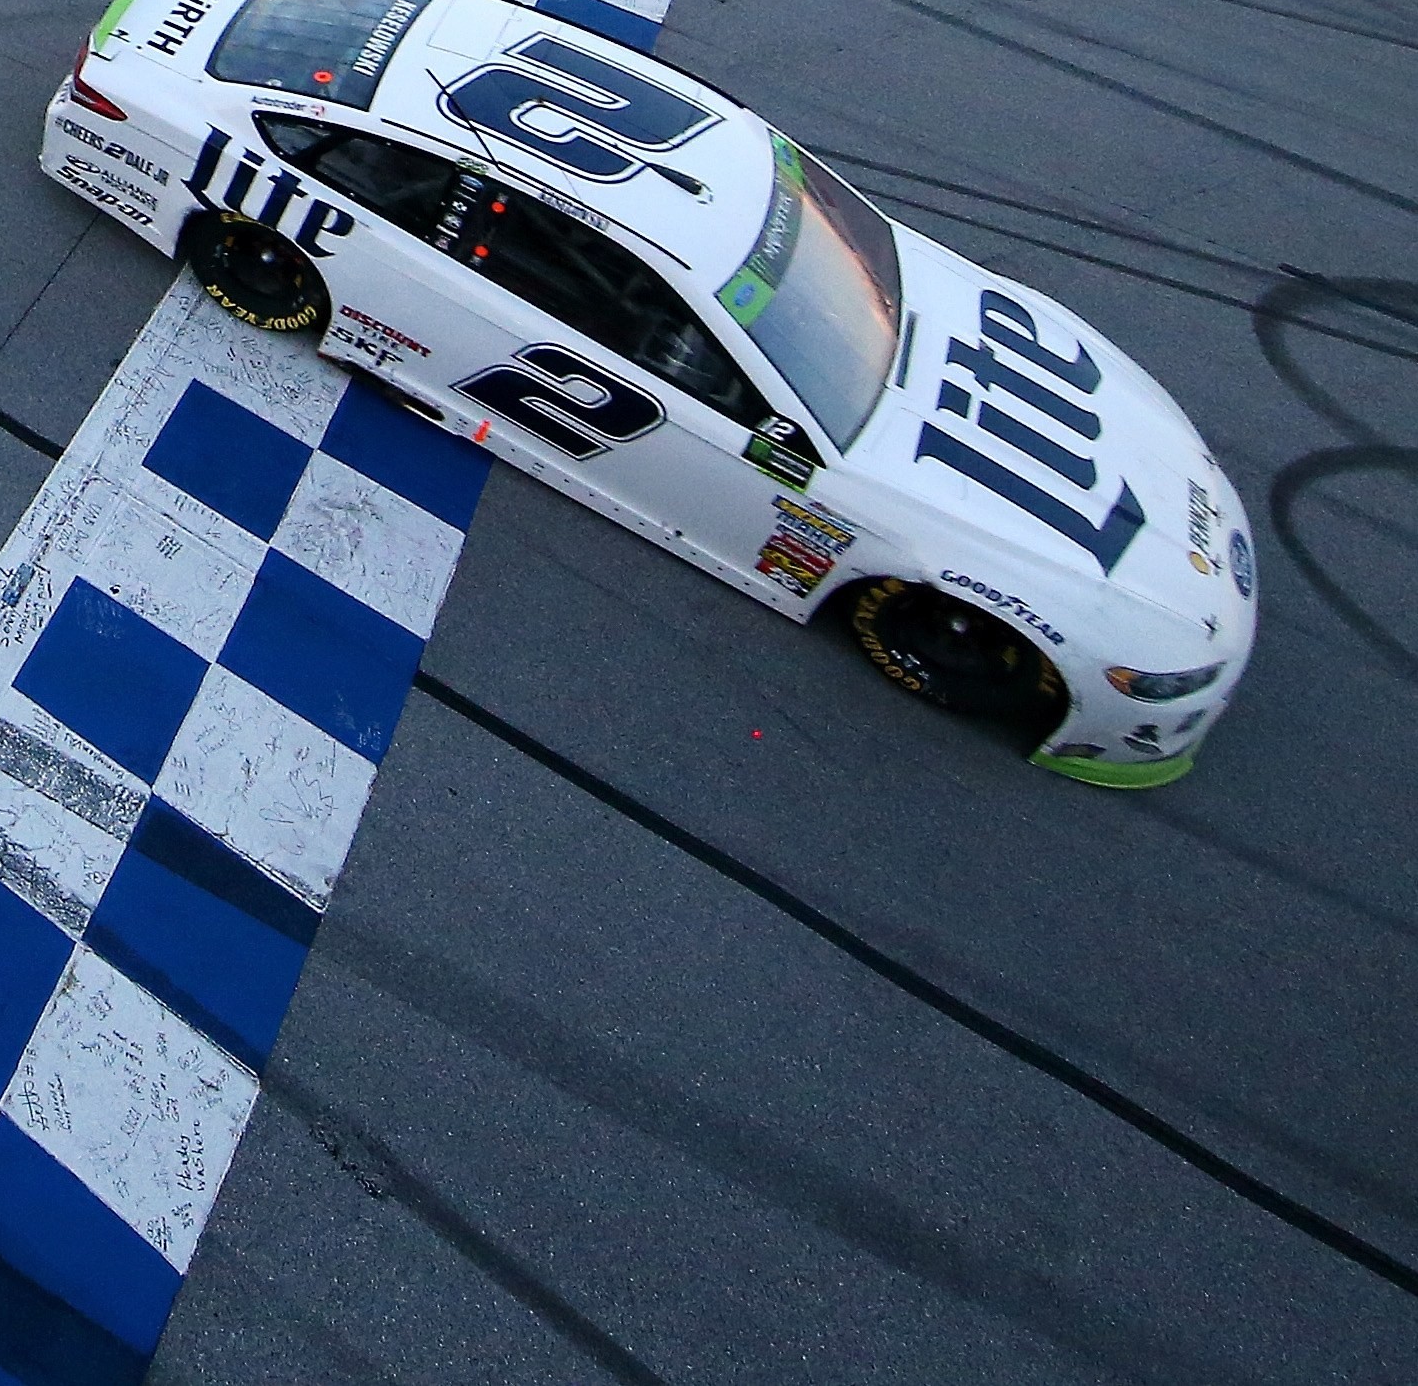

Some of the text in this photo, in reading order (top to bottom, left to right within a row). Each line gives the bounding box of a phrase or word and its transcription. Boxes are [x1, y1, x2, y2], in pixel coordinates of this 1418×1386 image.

[436, 30, 728, 185] 2
[329, 326, 405, 367] SKF
[448, 342, 667, 462] 2
[756, 415, 797, 442] 12
[940, 569, 1066, 646] GOODYEAR
